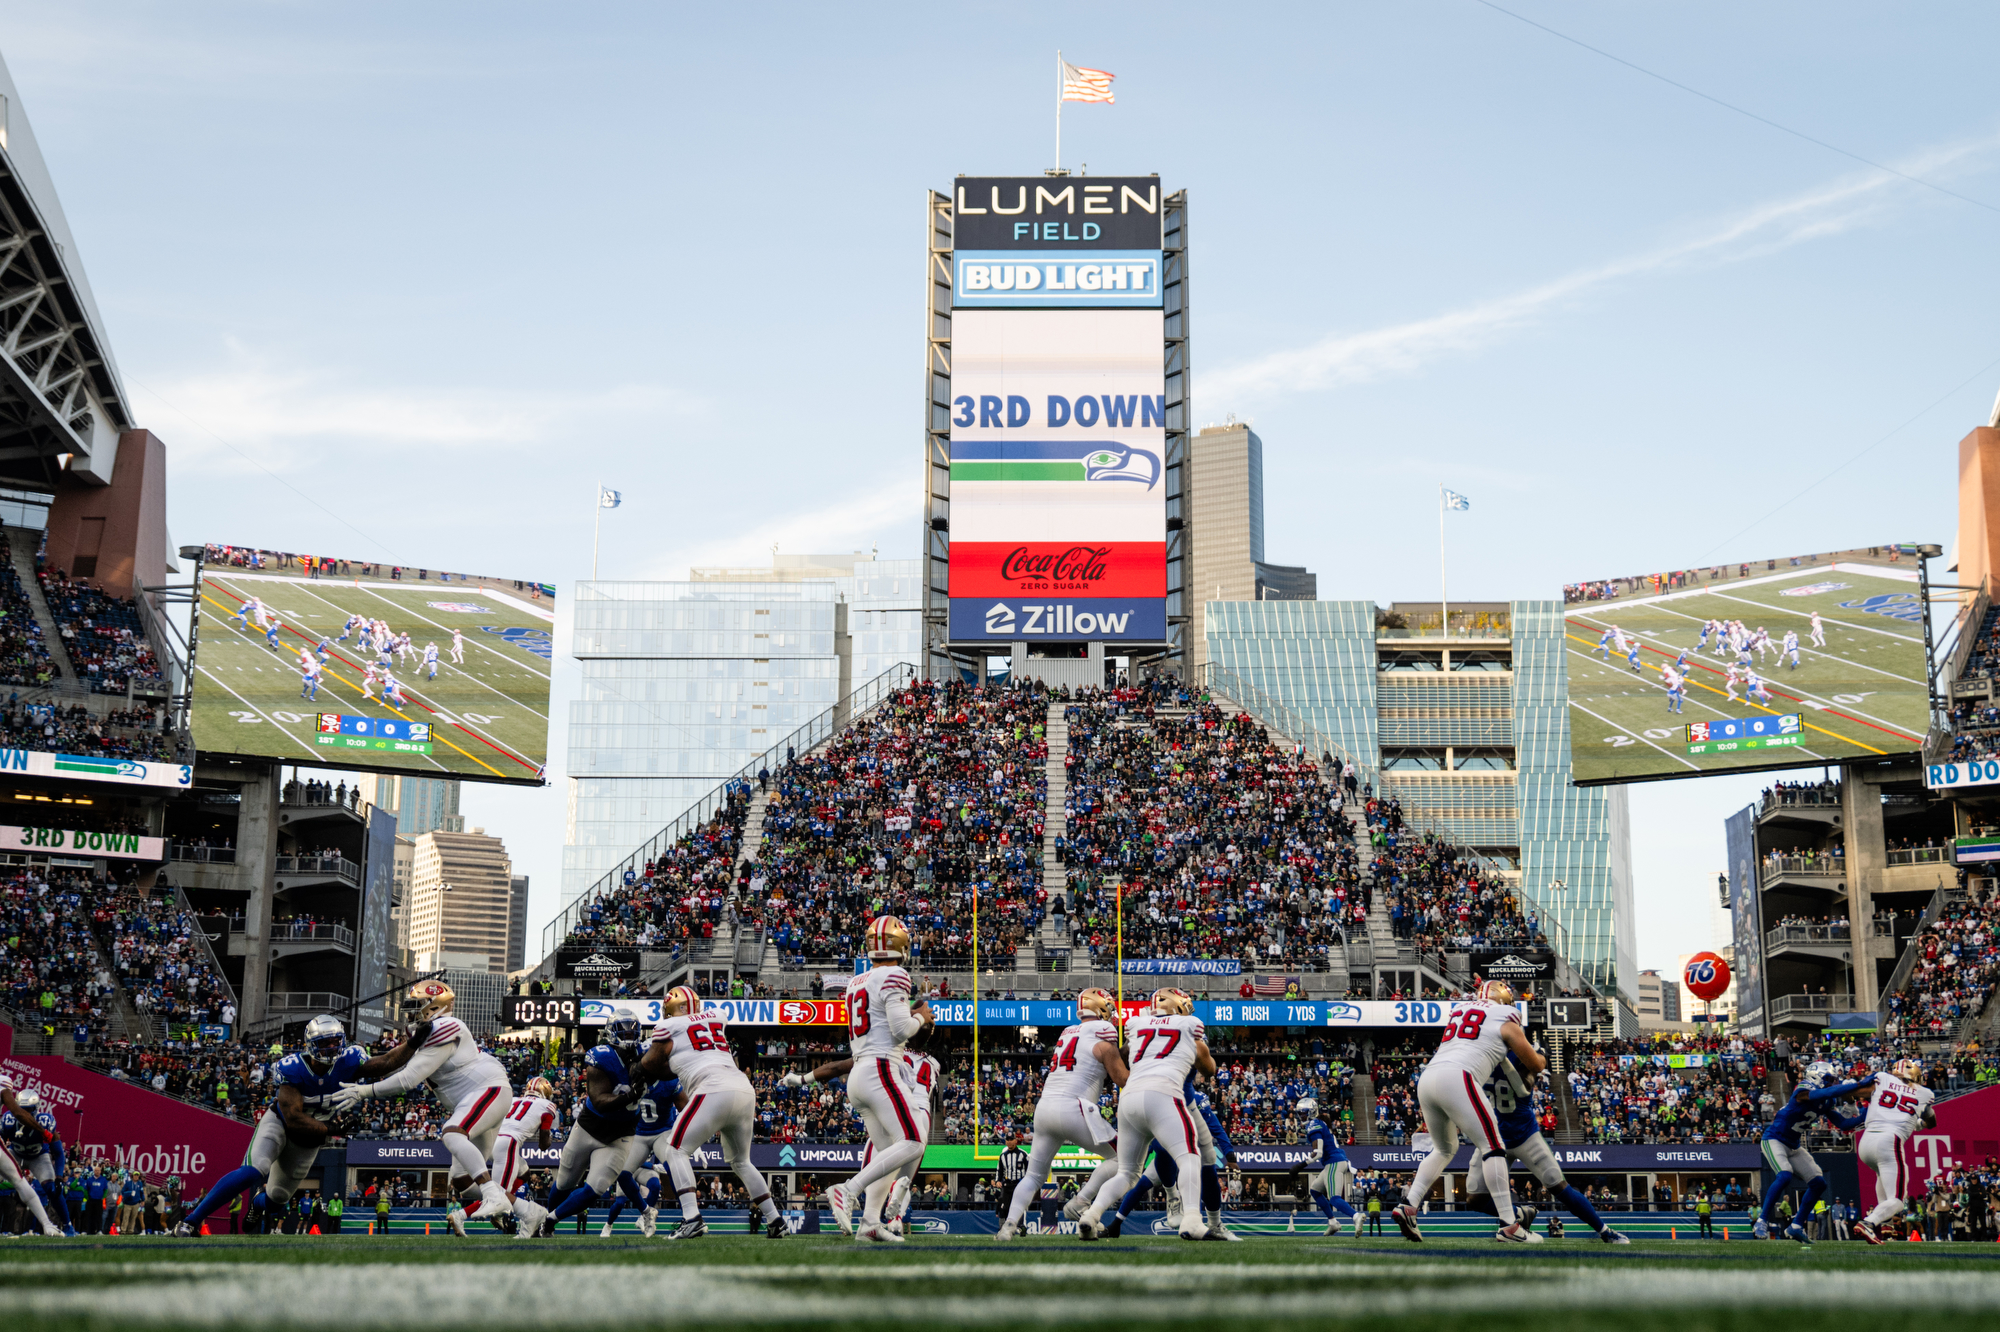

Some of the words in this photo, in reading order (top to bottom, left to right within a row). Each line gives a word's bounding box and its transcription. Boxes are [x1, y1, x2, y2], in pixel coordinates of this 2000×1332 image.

[958, 185, 1157, 215] LUMEN
[1014, 222, 1101, 240] FIELD
[966, 265, 1041, 290] BUD
[952, 395, 1031, 428] 3RD
[1047, 395, 1165, 428] DOWN
[1001, 546, 1113, 581] Coca-Cola
[1020, 582, 1049, 590] ZERO
[1053, 582, 1089, 590] SUGAR
[1022, 605, 1129, 634] Zillow
[134, 680, 168, 693] 344
[1955, 681, 1987, 693] 300
[356, 721, 367, 732] 0
[384, 723, 396, 735] 0
[1725, 724, 1736, 735] 0
[1753, 721, 1765, 732] 0
[318, 736, 335, 744] 1ST
[345, 738, 367, 747] 10:09
[1690, 745, 1706, 753] 1ST
[1717, 742, 1738, 751] 10:09
[178, 765, 191, 785] 3
[1929, 764, 1959, 786] RD
[20, 827, 65, 848] 3RD
[73, 830, 139, 854] DOWN
[1121, 961, 1154, 974] FEEL
[1158, 961, 1189, 974] THE
[1193, 961, 1239, 974] NOISE!
[1687, 959, 1715, 985] 76
[515, 1001, 575, 1022] 10:09
[825, 1003, 834, 1022] 0
[847, 988, 871, 1041] 13
[933, 1005, 953, 1022] 3rd
[955, 1005, 965, 1022] &
[966, 1005, 974, 1022] 2
[985, 1008, 1003, 1018] BALL
[1004, 1008, 1016, 1018] ON
[1021, 1006, 1029, 1021] 11
[1047, 1008, 1062, 1019] QTR
[1215, 1006, 1233, 1021] #13
[1242, 1006, 1270, 1021] RUSH
[1287, 1006, 1294, 1021] 7
[1295, 1006, 1316, 1021] YDS
[1395, 1002, 1441, 1023] 3RD
[1555, 1005, 1568, 1023] 4
[1149, 1017, 1170, 1025] PUNI
[1442, 1008, 1487, 1043] 68
[687, 1022, 731, 1054] 65
[1136, 1028, 1182, 1063] 77
[2, 1057, 42, 1078] AMERICA'S
[1690, 1056, 1698, 1065] F
[13, 1073, 24, 1088] &
[26, 1076, 84, 1109] FASTEST
[1888, 1080, 1918, 1096] KITTLE
[378, 1148, 404, 1158] SUITE
[406, 1148, 434, 1158] LEVEL
[800, 1150, 853, 1162] UMPQUA
[1285, 1152, 1318, 1163] BAN
[1372, 1152, 1399, 1162] SUITE
[1400, 1152, 1426, 1162] LEVEL
[1566, 1151, 1602, 1163] BANK
[1656, 1151, 1683, 1161] SUITE
[1685, 1151, 1713, 1161] LEVEL
